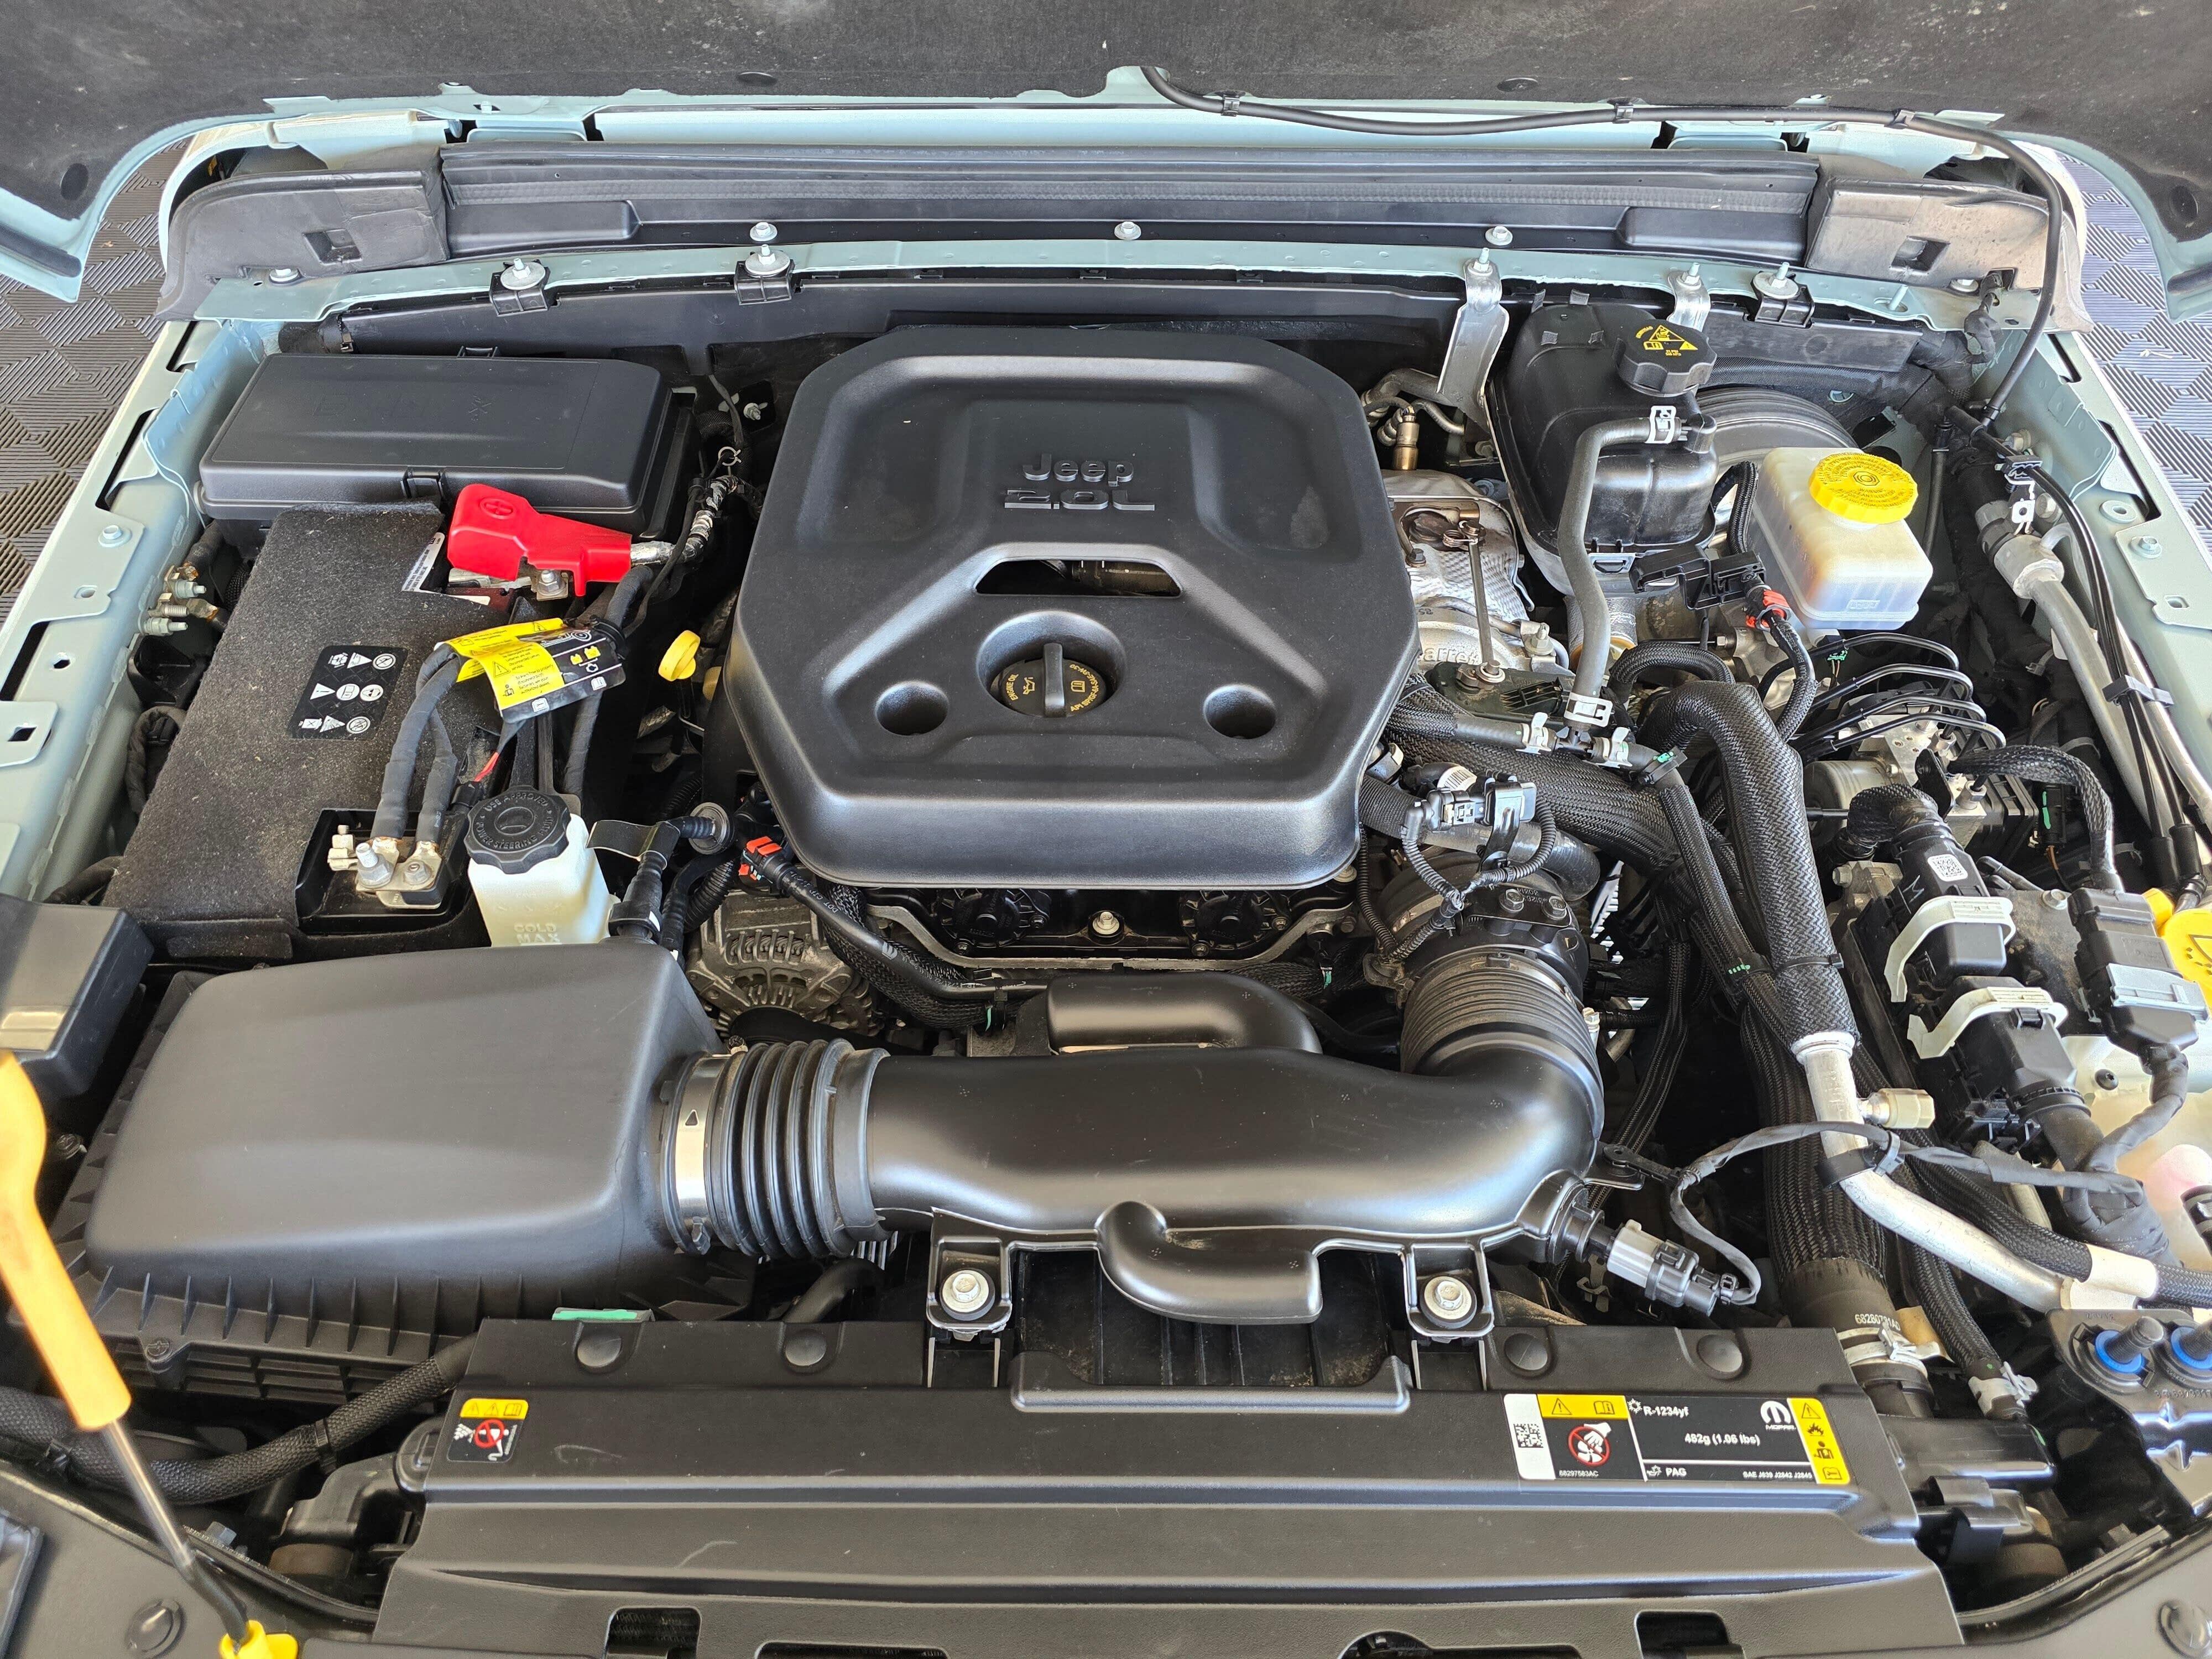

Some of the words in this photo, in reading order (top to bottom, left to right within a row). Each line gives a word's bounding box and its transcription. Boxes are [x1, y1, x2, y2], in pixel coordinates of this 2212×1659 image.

[1022, 453, 1134, 487] Jeep
[1004, 489, 1155, 511] 2.0L
[1423, 647, 1483, 666] arrett
[1009, 673, 1019, 681] OIL
[1006, 681, 1019, 701] ENGINE
[1070, 703, 1084, 712] API
[484, 798, 502, 812] USE
[503, 791, 549, 807] APPROVED
[476, 821, 494, 847] POWER
[493, 834, 539, 851] STEERING
[513, 922, 557, 933] COLD
[515, 932, 561, 944] MAX
[1643, 1406, 1689, 1418] R-1234yf
[1684, 1433, 1711, 1446] 482g
[1712, 1434, 1738, 1446] (1.06
[1739, 1433, 1761, 1447] lbs)
[1665, 1467, 1687, 1477] PAG
